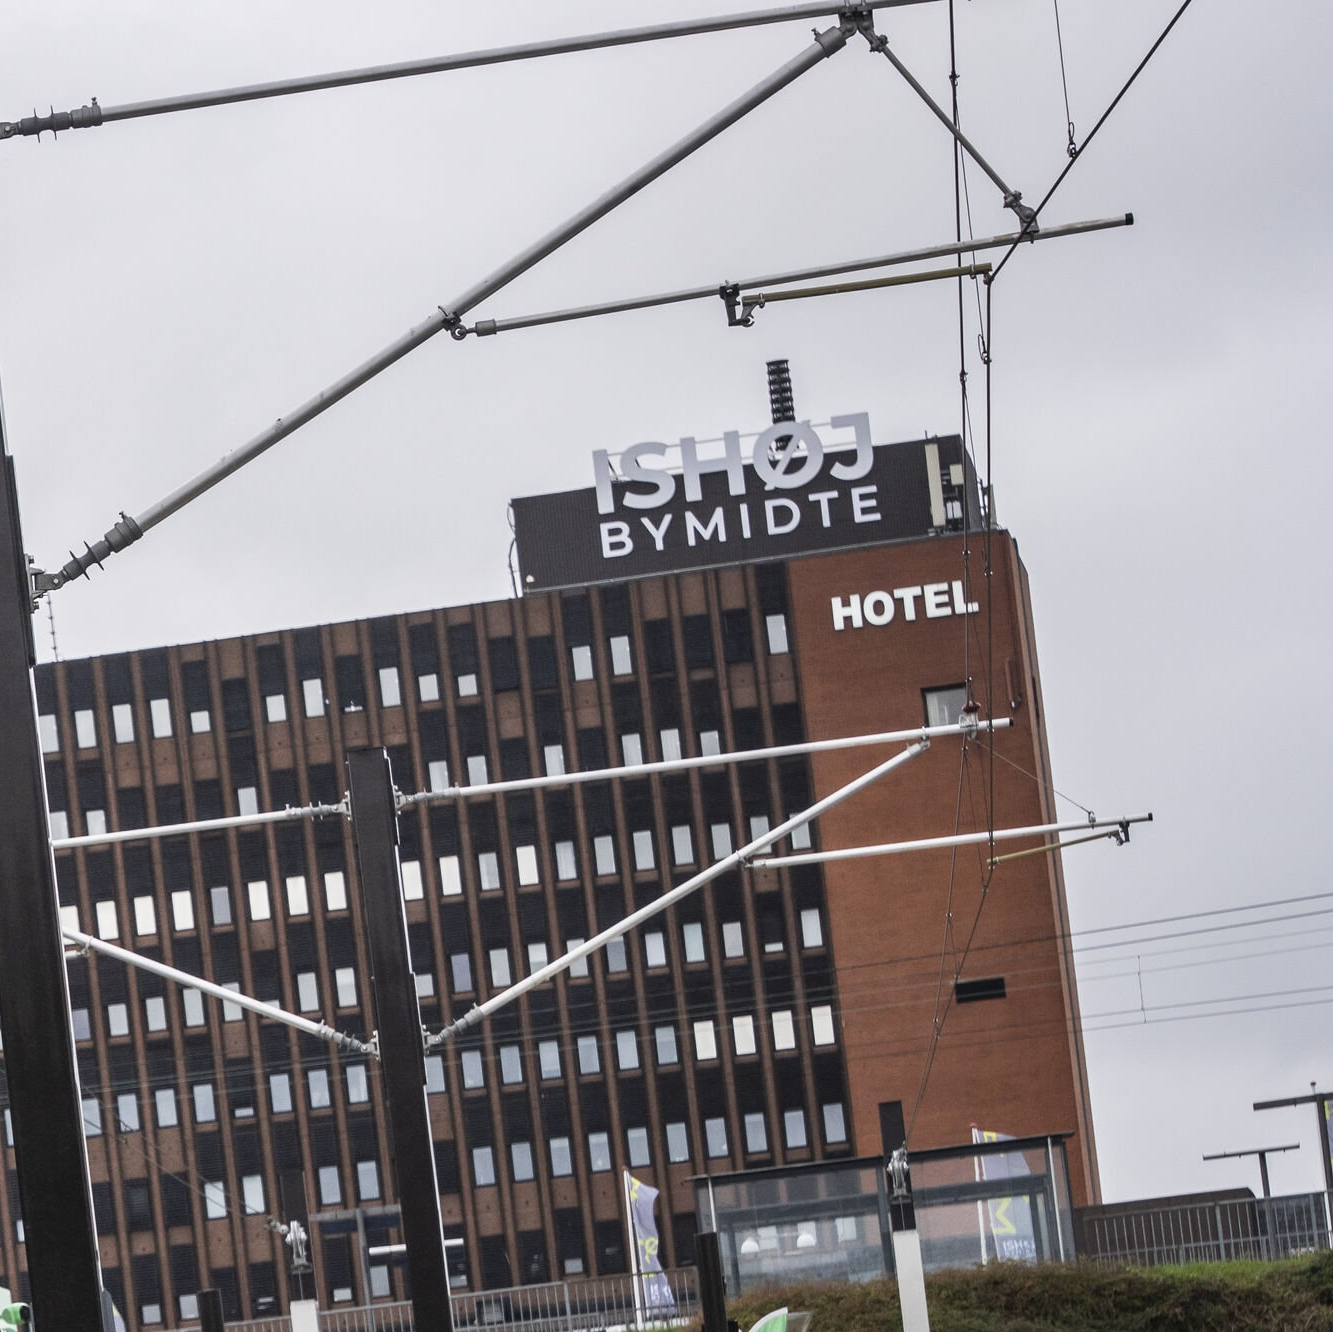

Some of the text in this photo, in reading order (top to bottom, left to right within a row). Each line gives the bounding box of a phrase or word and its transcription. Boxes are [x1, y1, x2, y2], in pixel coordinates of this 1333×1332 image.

[591, 411, 875, 516] ISHØJ
[599, 484, 883, 559] BYMIDTE
[831, 580, 980, 632] HOTEL
